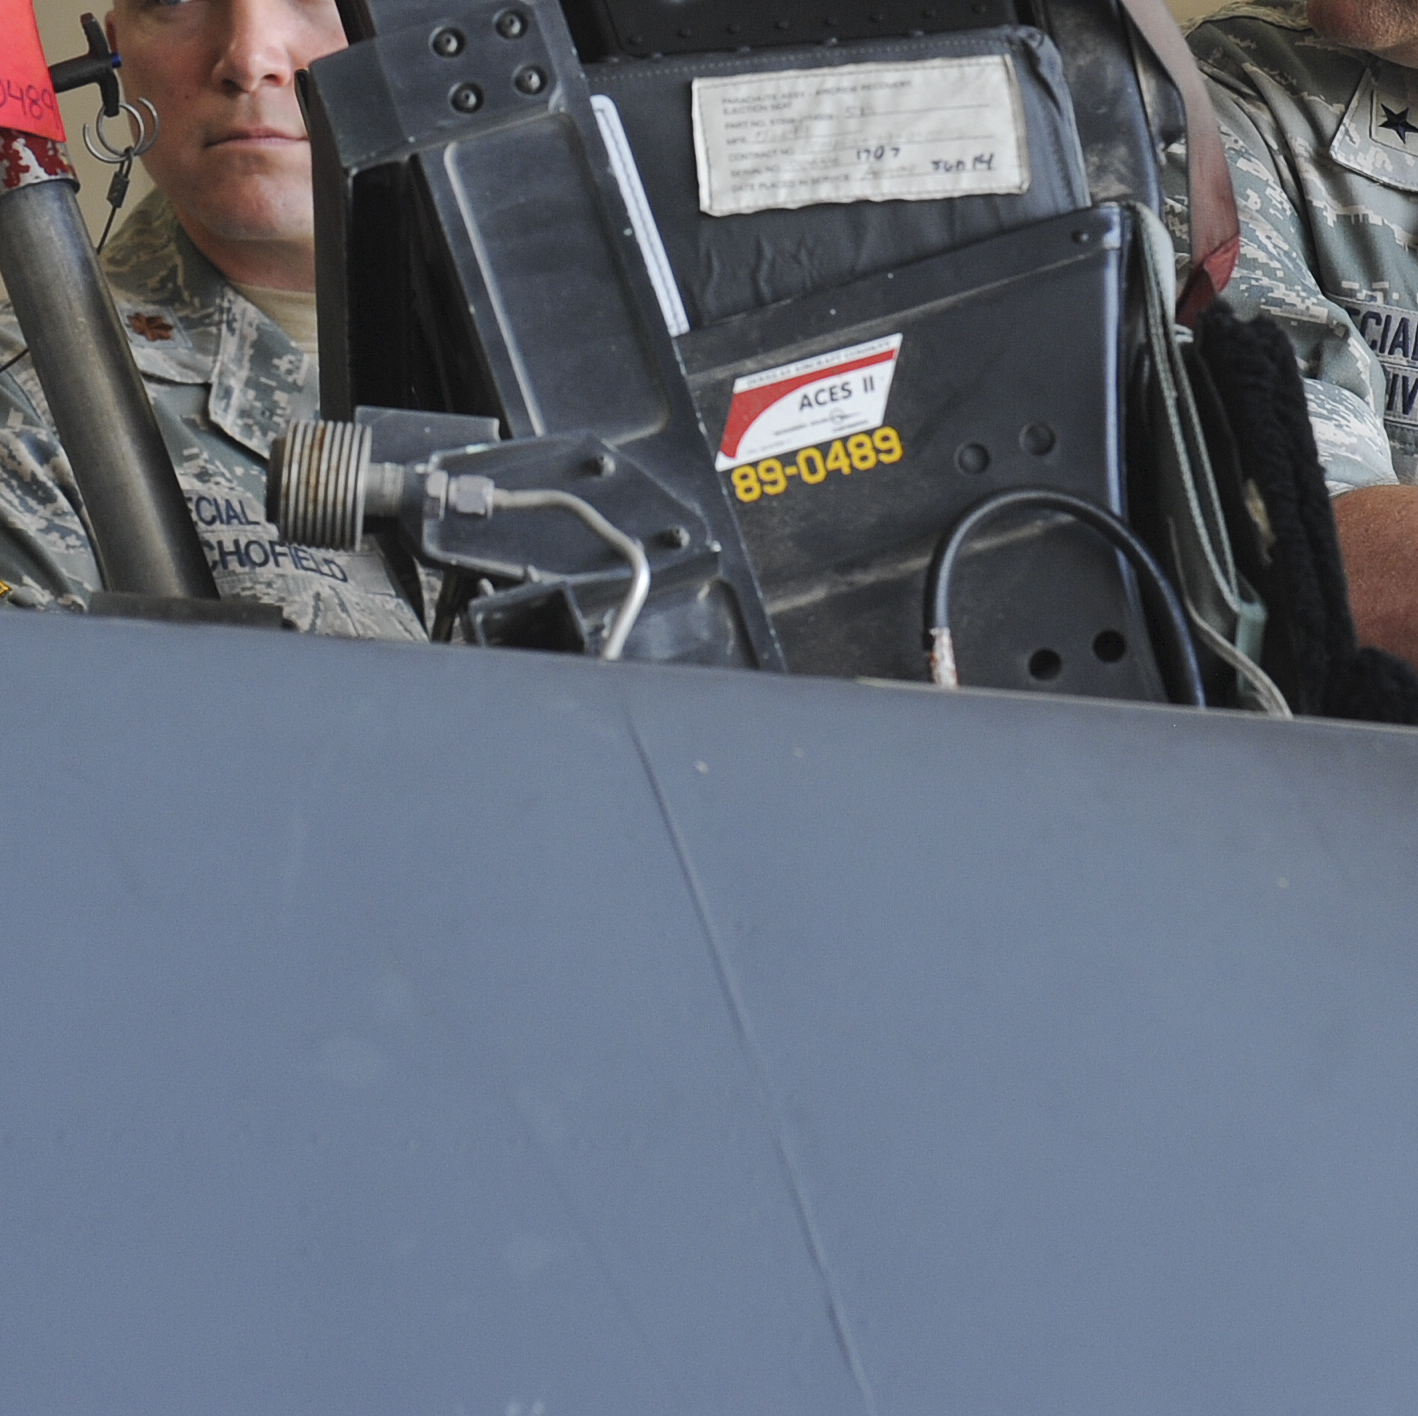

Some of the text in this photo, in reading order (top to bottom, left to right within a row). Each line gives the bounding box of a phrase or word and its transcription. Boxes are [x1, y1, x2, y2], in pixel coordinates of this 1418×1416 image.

[799, 381, 853, 412] ACES
[731, 426, 904, 503] 89-0489
[185, 496, 261, 526] CIAL
